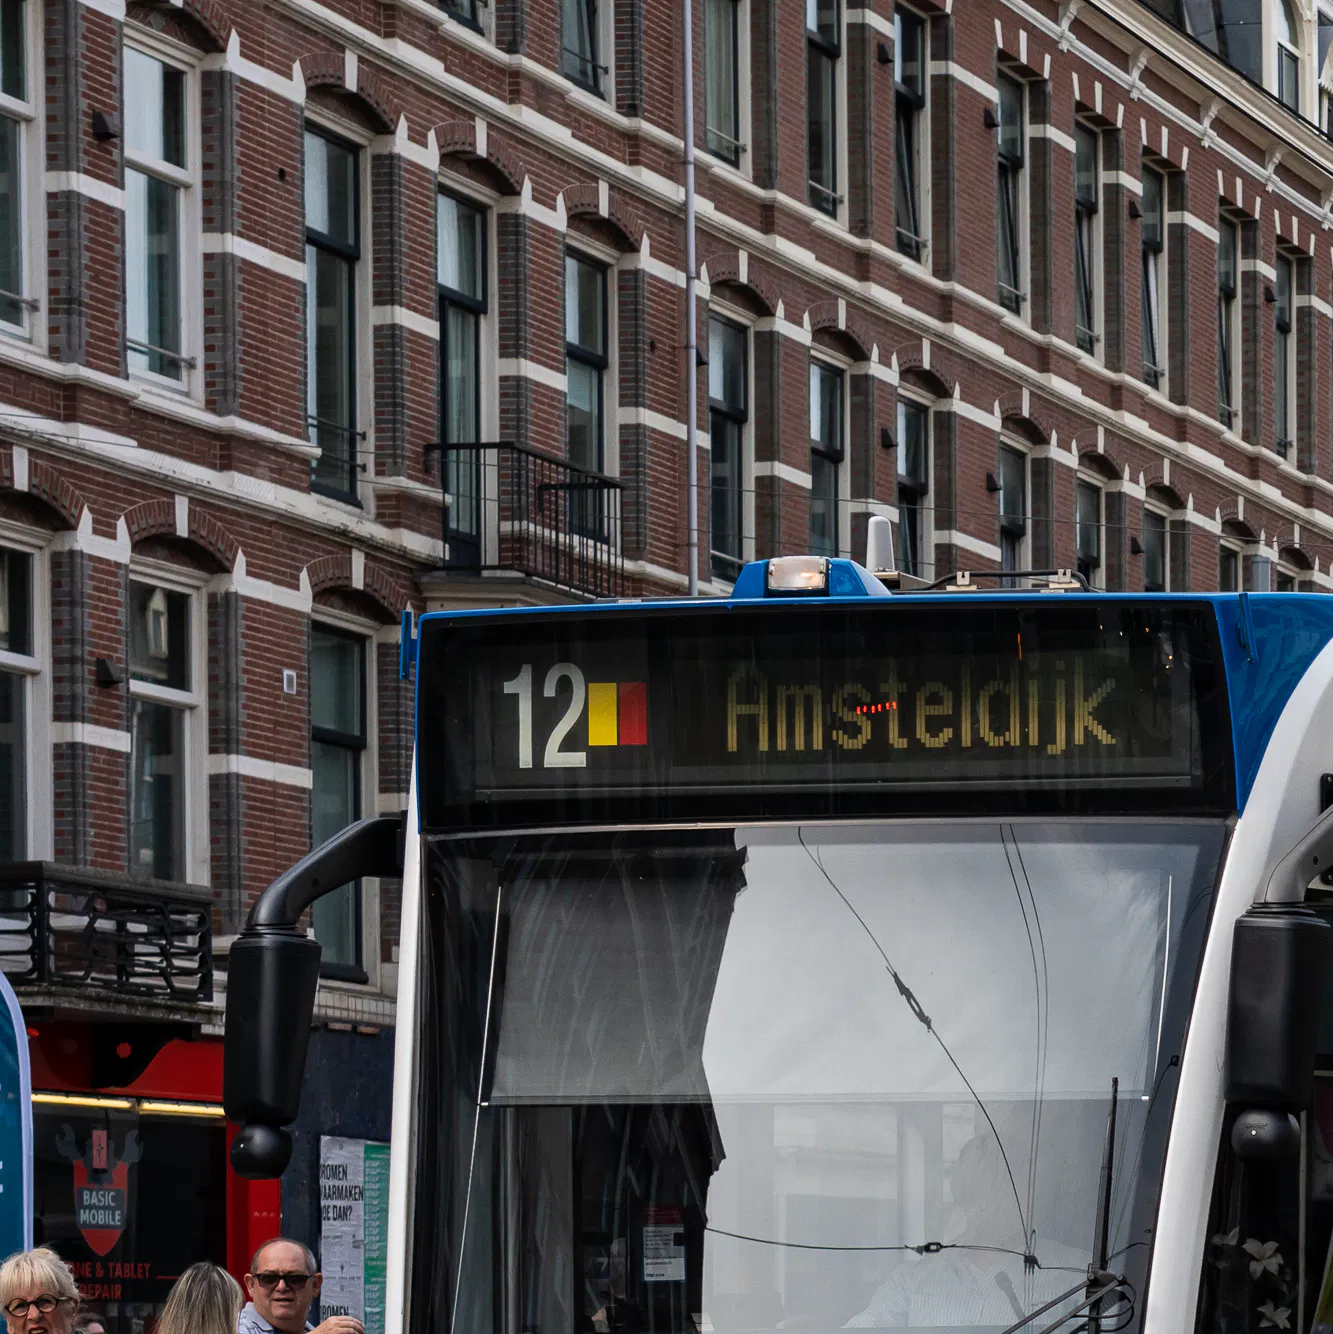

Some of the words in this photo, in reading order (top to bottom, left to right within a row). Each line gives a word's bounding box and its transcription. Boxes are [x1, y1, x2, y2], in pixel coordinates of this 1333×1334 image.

[727, 657, 1117, 755] Amsteldijk
[503, 661, 587, 769] 12
[320, 1164, 347, 1181] ROMEN
[83, 1190, 116, 1206] BASIC
[80, 1209, 121, 1225] MOBILE
[108, 1262, 150, 1279] TABLET
[79, 1284, 122, 1300] REPAIR
